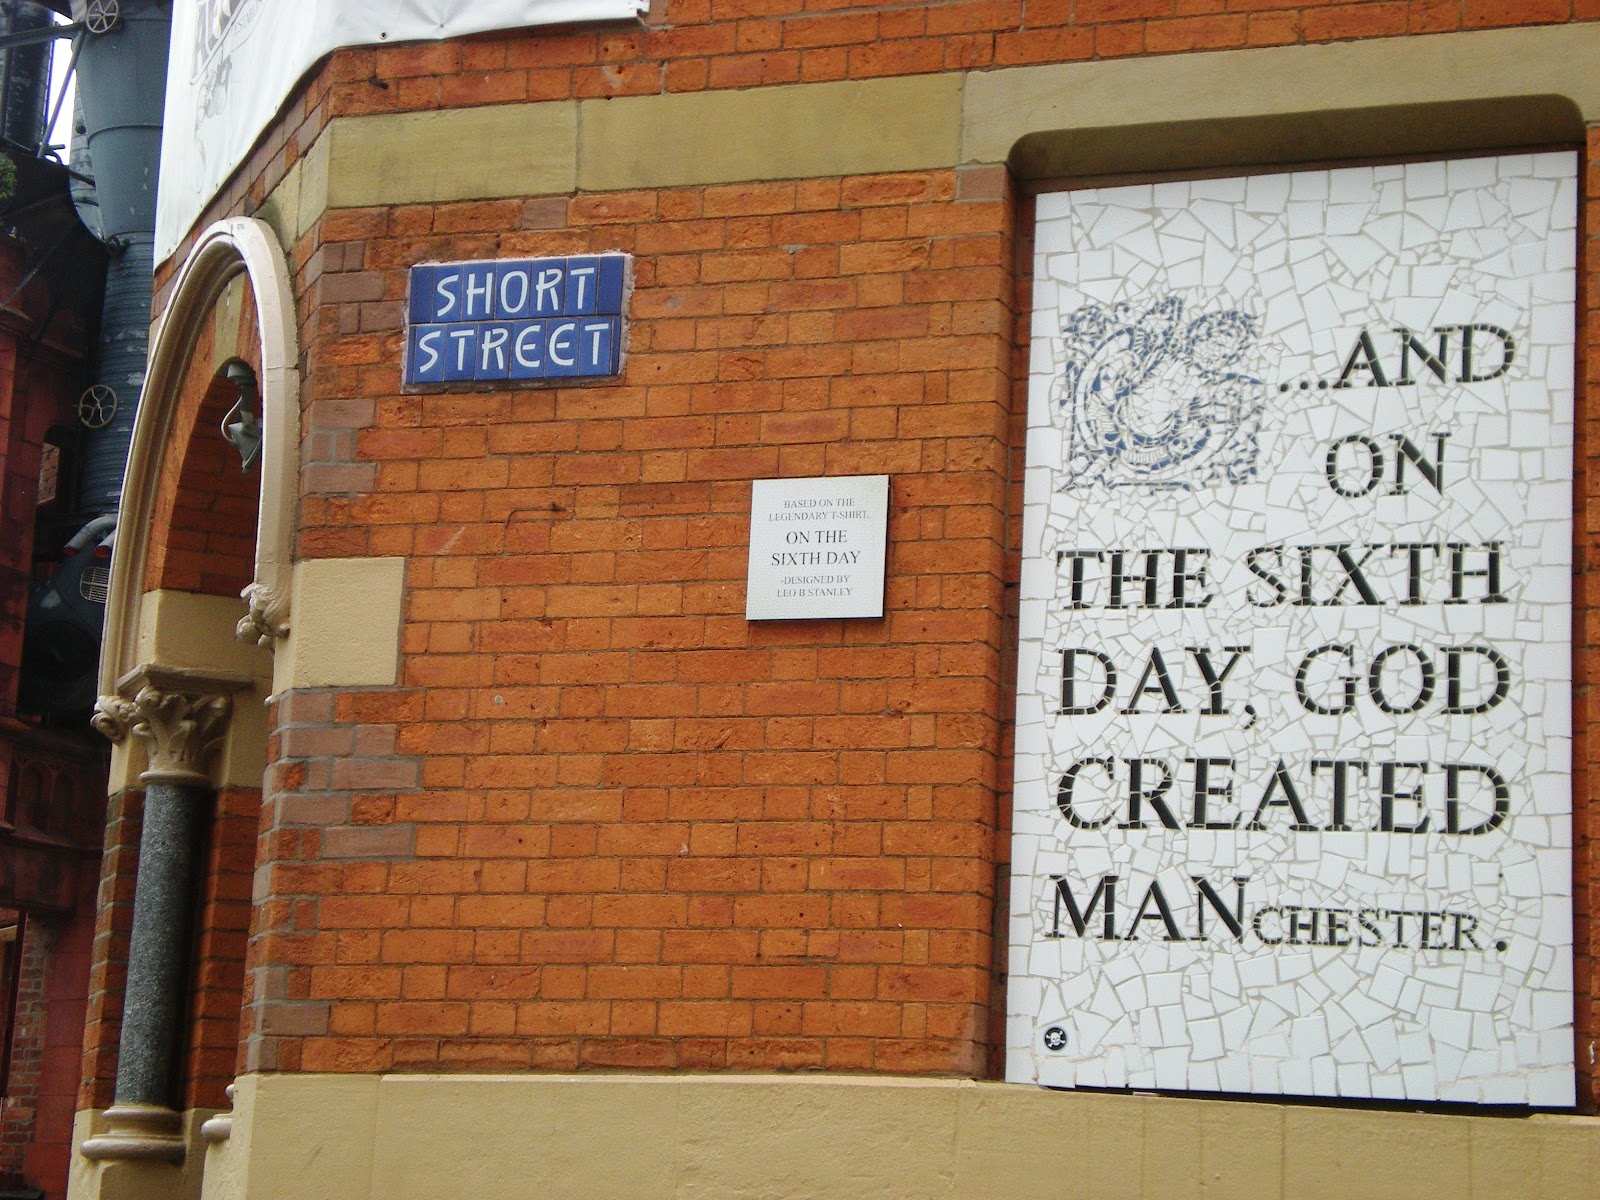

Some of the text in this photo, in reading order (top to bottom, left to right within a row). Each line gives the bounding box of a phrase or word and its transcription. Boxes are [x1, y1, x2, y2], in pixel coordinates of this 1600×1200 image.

[436, 267, 595, 317] SHORT
[418, 323, 609, 373] STREET
[1326, 431, 1451, 498] ON
[769, 511, 829, 522] LEGENDARY
[784, 498, 855, 509] BASED ON THE
[786, 530, 848, 545] ON THE
[771, 551, 861, 567] SIXTH DAY
[1056, 540, 1510, 610] THE SIXTH
[777, 588, 797, 598] LEO
[807, 587, 853, 597] STANLEY
[836, 575, 850, 584] BY
[1056, 643, 1512, 730] DAY, GOD
[1056, 756, 1511, 836] CREATED
